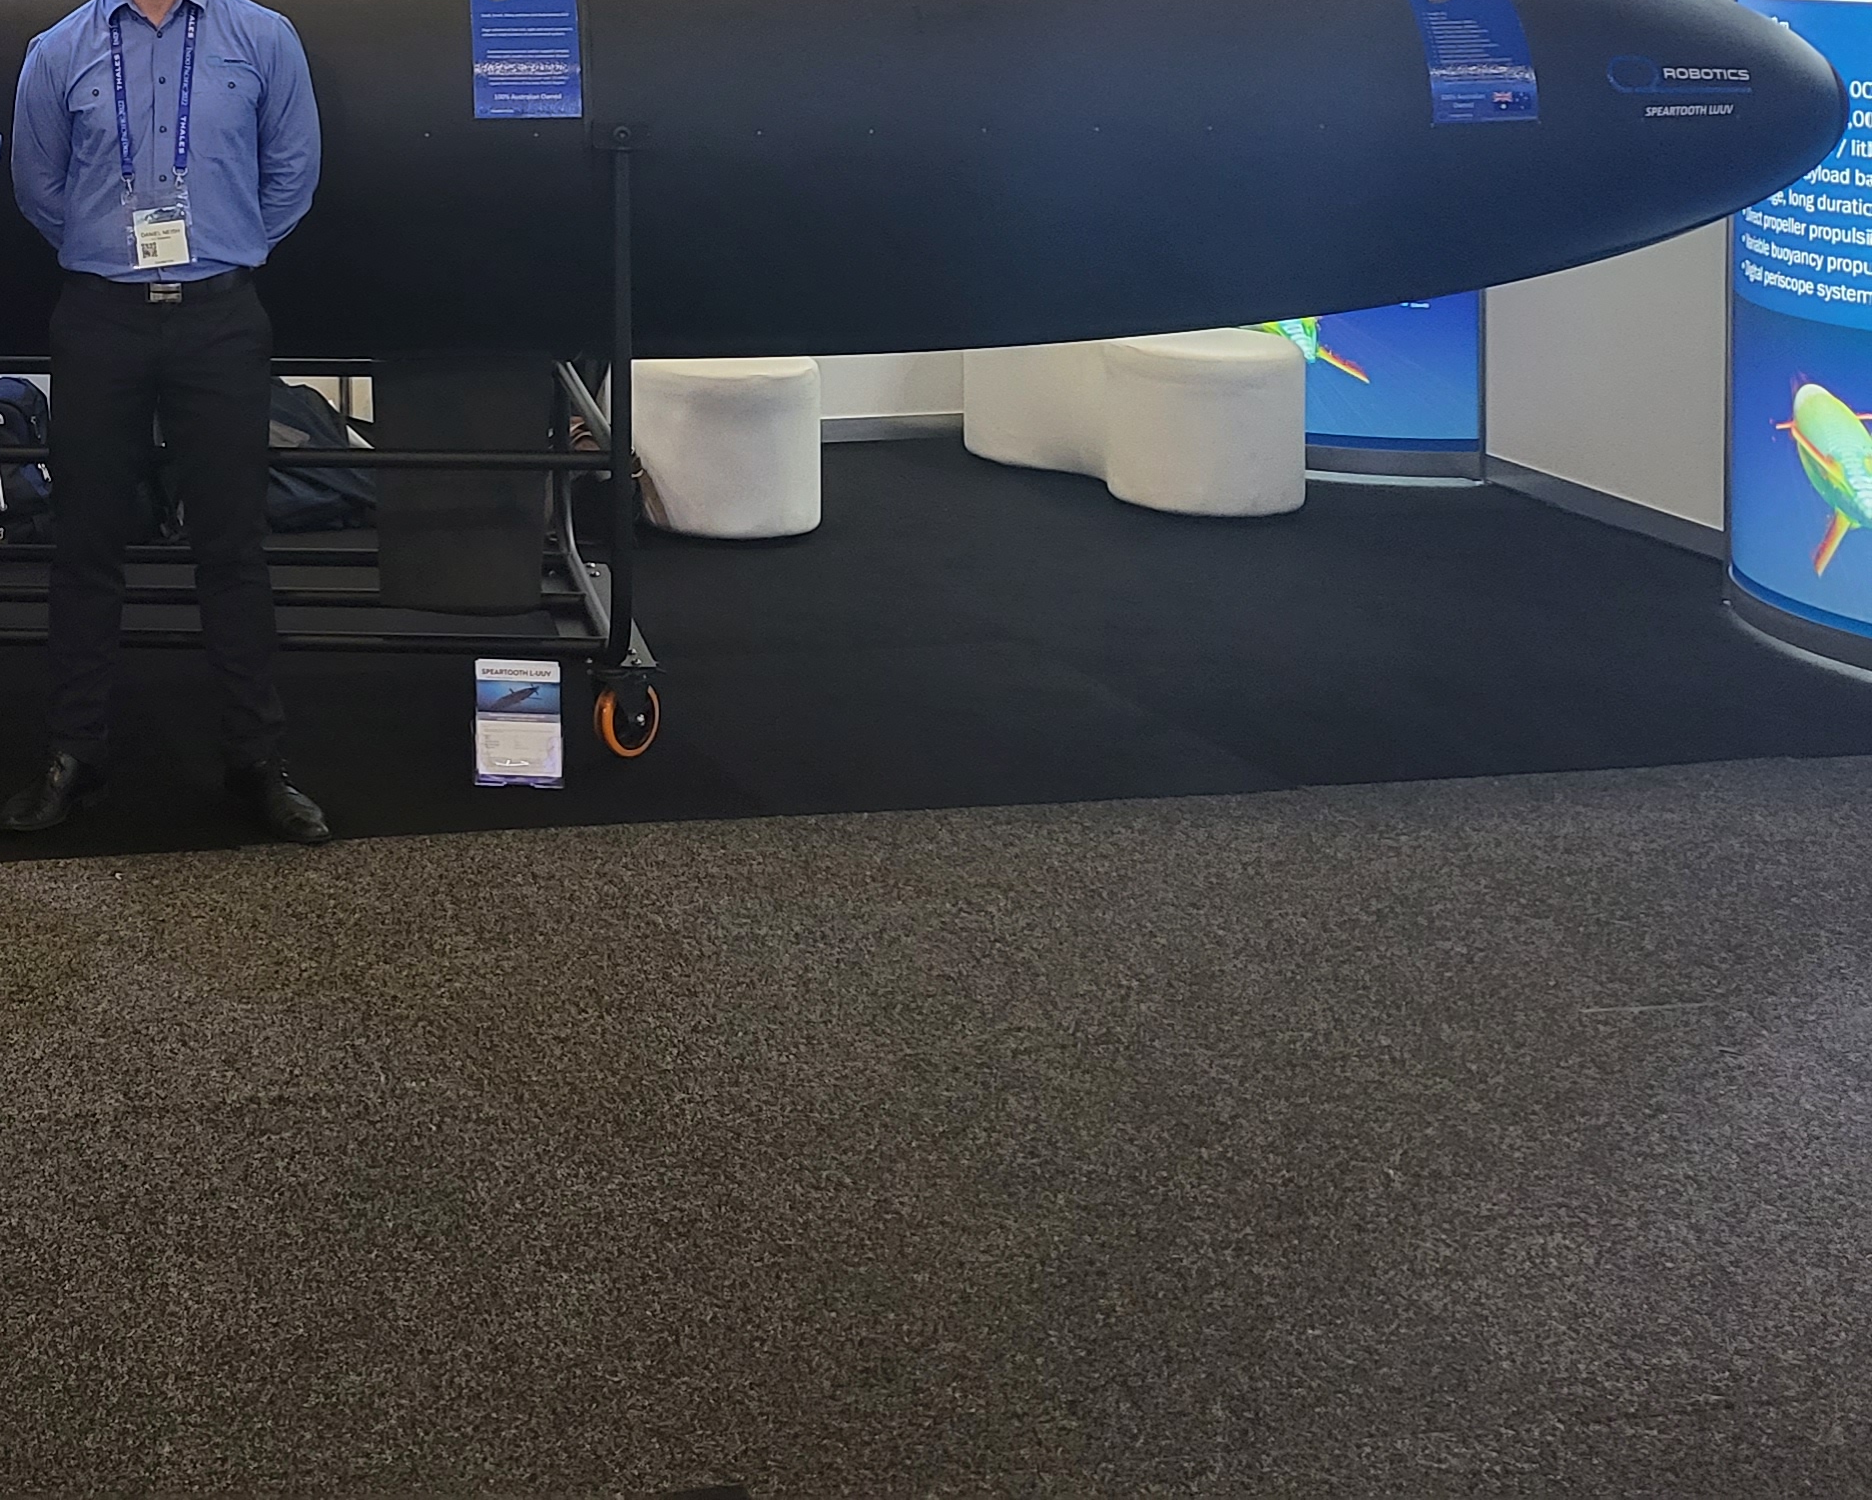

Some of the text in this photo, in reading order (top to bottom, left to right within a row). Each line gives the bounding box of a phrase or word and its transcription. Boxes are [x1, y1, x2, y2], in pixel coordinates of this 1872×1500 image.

[113, 54, 123, 91] THALES
[1663, 68, 1750, 81] ROBOTICS
[1644, 105, 1707, 117] SPEARTOOTH
[178, 116, 187, 154] THALES
[1789, 189, 1815, 212] long
[1764, 214, 1806, 236] propeller
[1771, 242, 1824, 271] buoyancy
[1764, 271, 1814, 296] periscope
[482, 668, 528, 676] SPEARTOOTH
